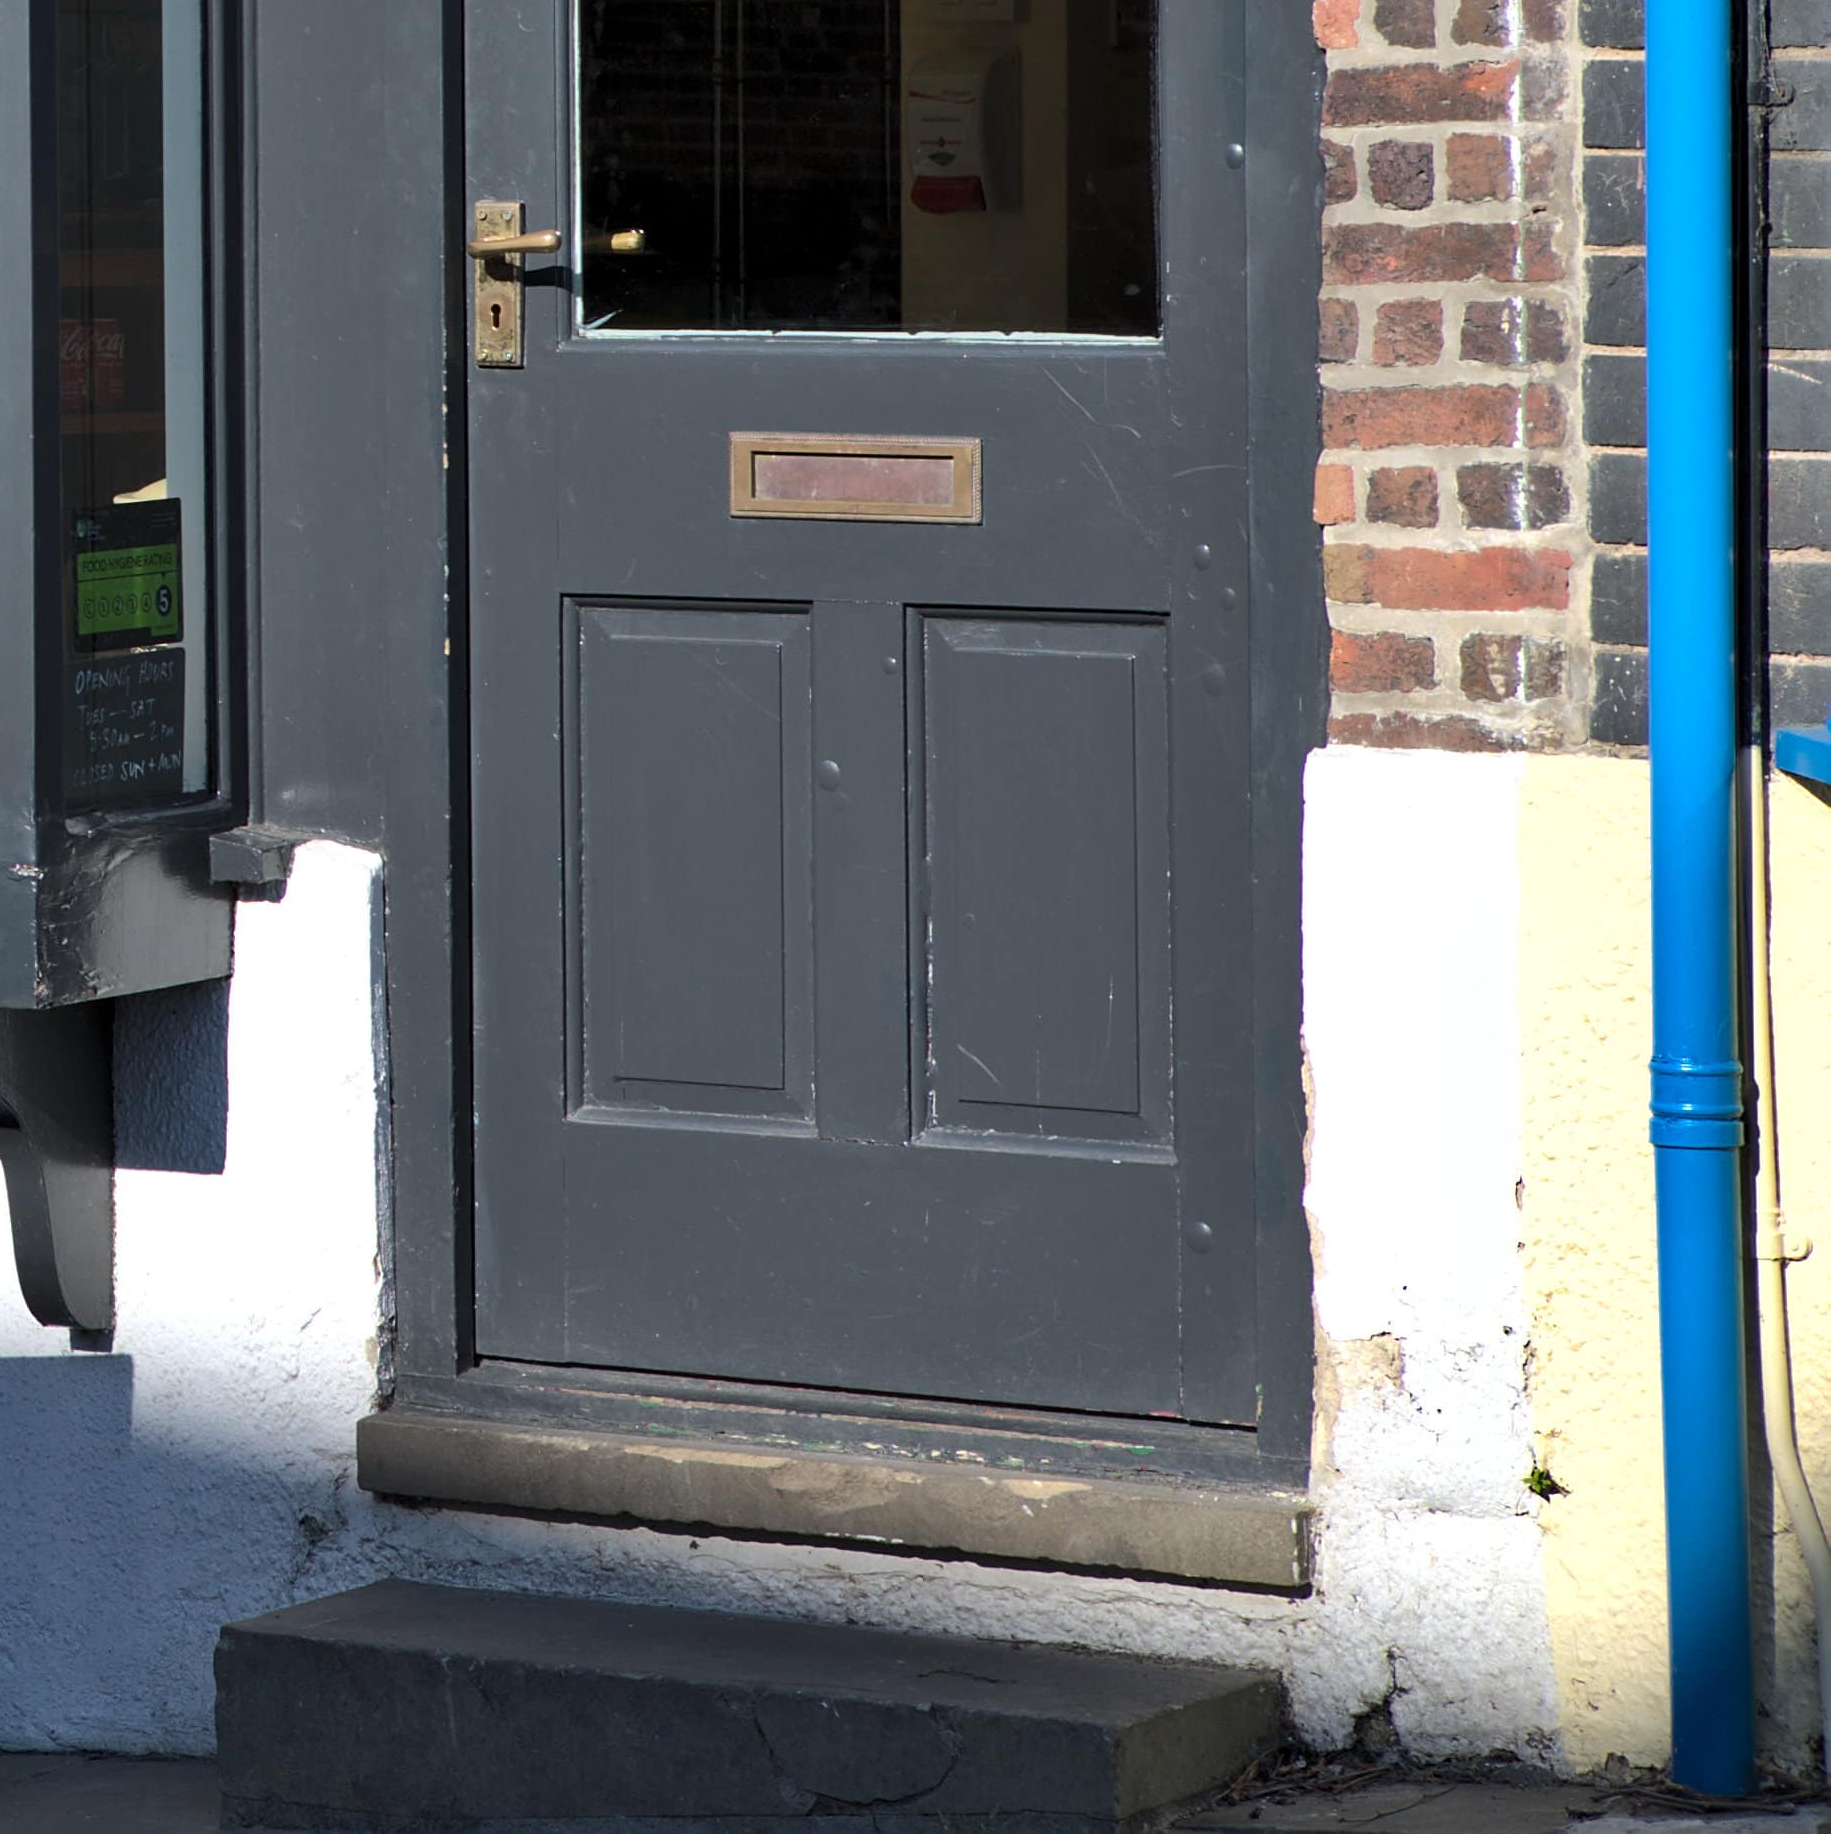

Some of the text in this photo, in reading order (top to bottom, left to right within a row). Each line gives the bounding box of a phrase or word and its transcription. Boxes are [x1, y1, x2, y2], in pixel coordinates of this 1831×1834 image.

[82, 552, 172, 572] FOOD HYGIENE RATING
[74, 659, 174, 697] OPENING HOURS
[129, 697, 156, 719] SAT
[120, 759, 146, 782] SUN
[158, 750, 182, 771] MON
